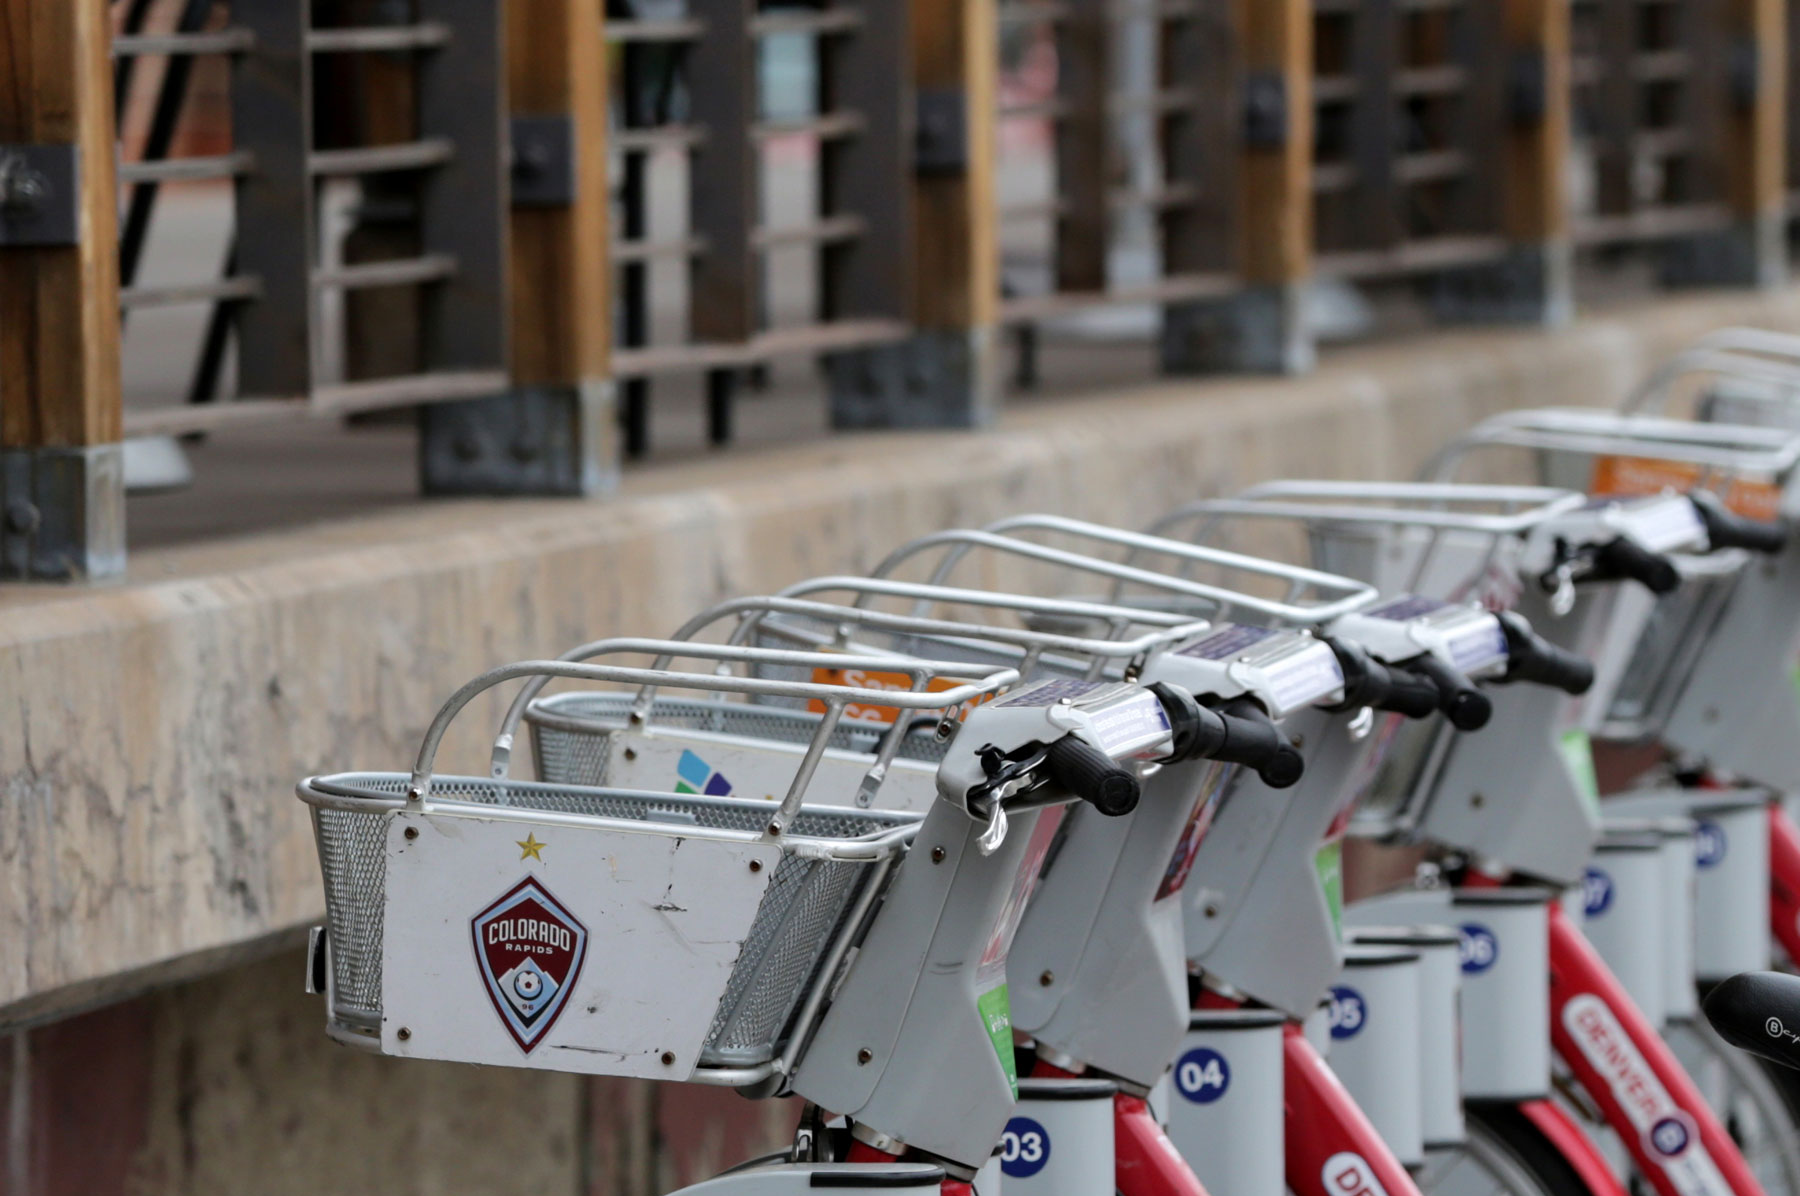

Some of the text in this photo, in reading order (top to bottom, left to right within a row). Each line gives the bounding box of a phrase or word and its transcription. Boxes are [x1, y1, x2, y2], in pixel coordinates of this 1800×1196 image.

[488, 918, 571, 952] COLORADO
[505, 943, 553, 955] RAPIDS
[522, 1003, 534, 1011] 96
[1179, 1058, 1224, 1093] 04
[1000, 1131, 1043, 1162] 03
